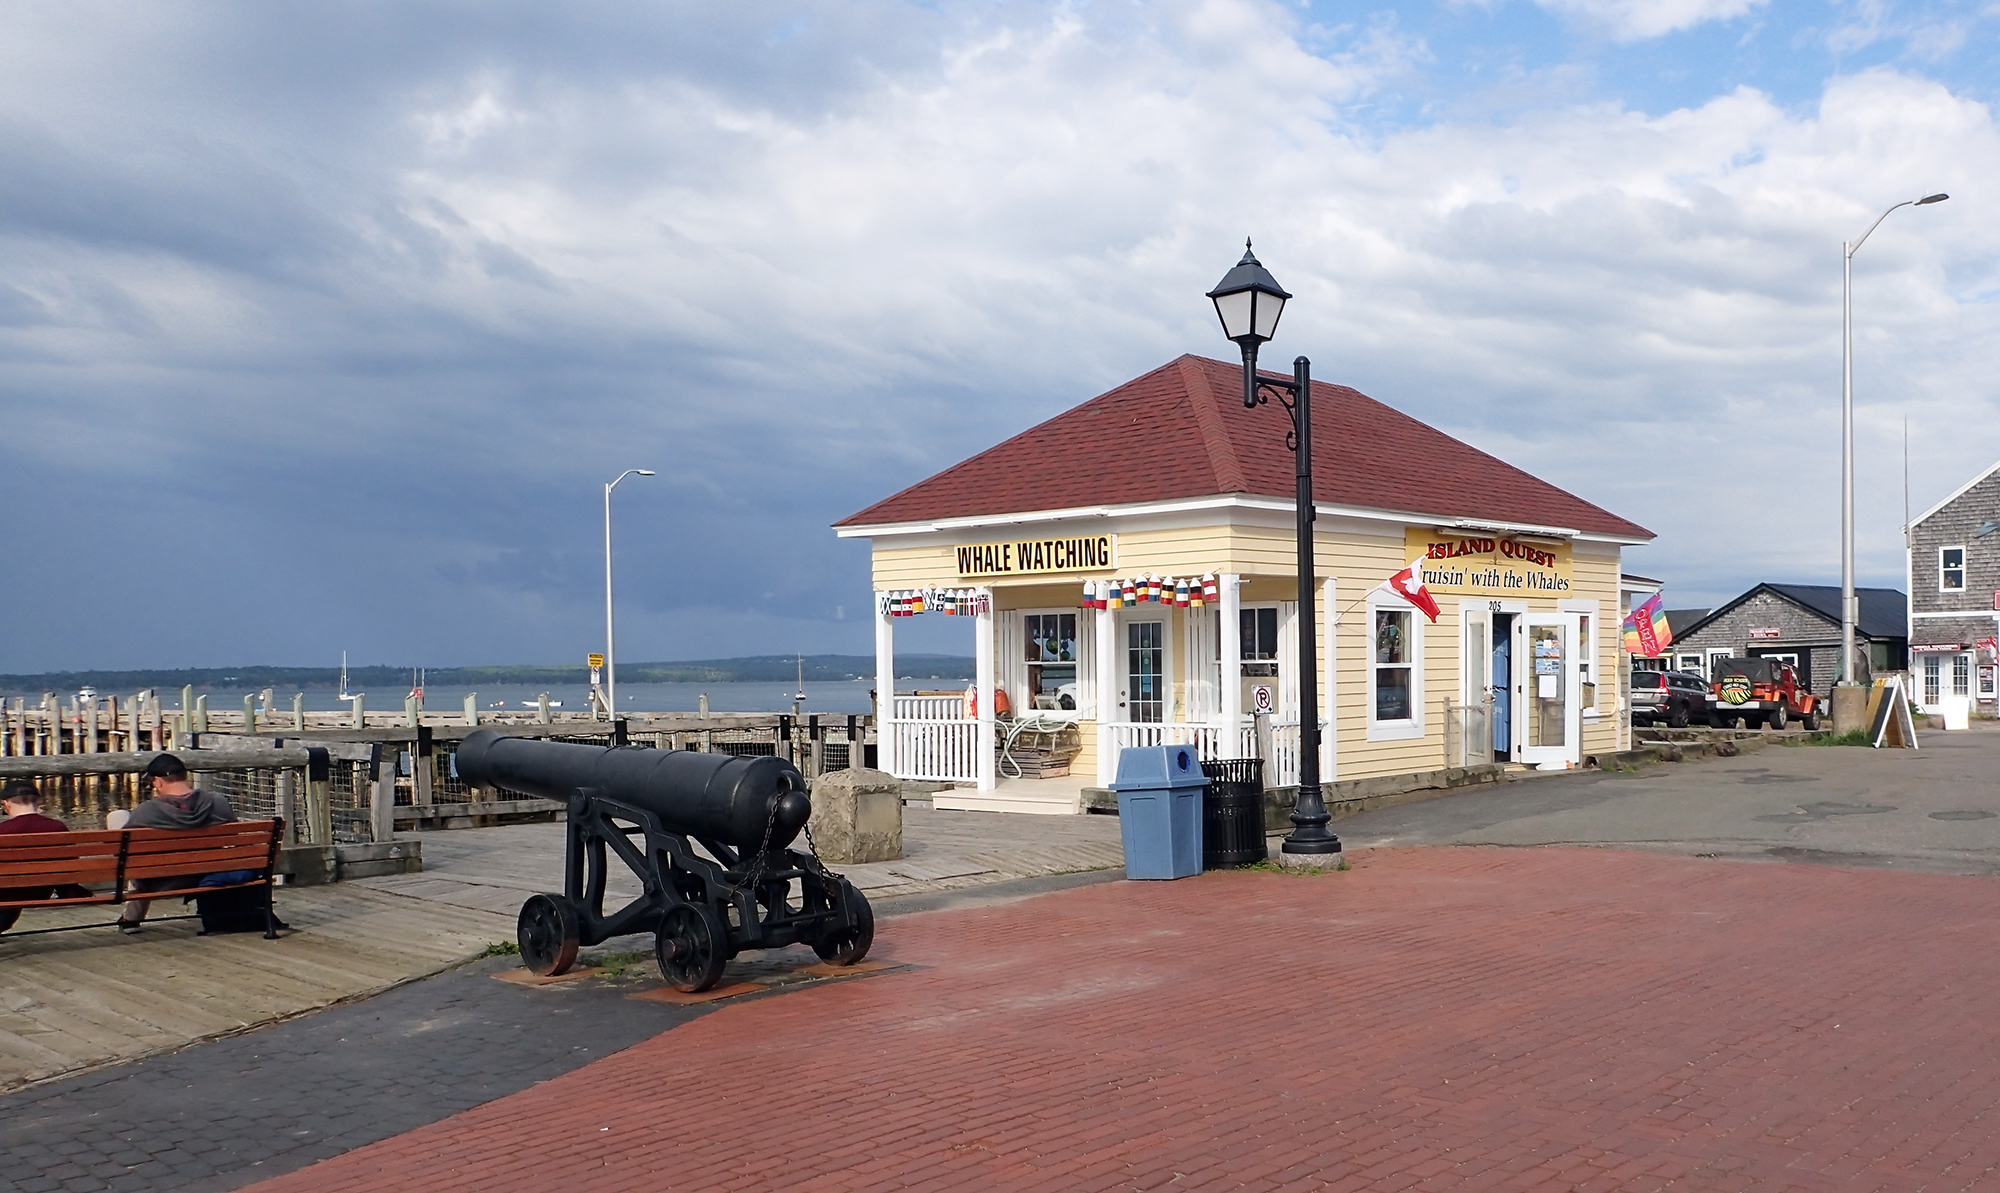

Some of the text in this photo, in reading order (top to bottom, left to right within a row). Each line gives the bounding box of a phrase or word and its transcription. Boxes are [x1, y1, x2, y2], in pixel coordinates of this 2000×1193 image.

[957, 537, 1109, 574] WHALE WATCHING
[1427, 538, 1556, 568] ISLAND QUEST
[1420, 565, 1570, 591] ruisin' with the Whales
[1488, 600, 1502, 612] 205
[1635, 608, 1657, 654] OPEN
